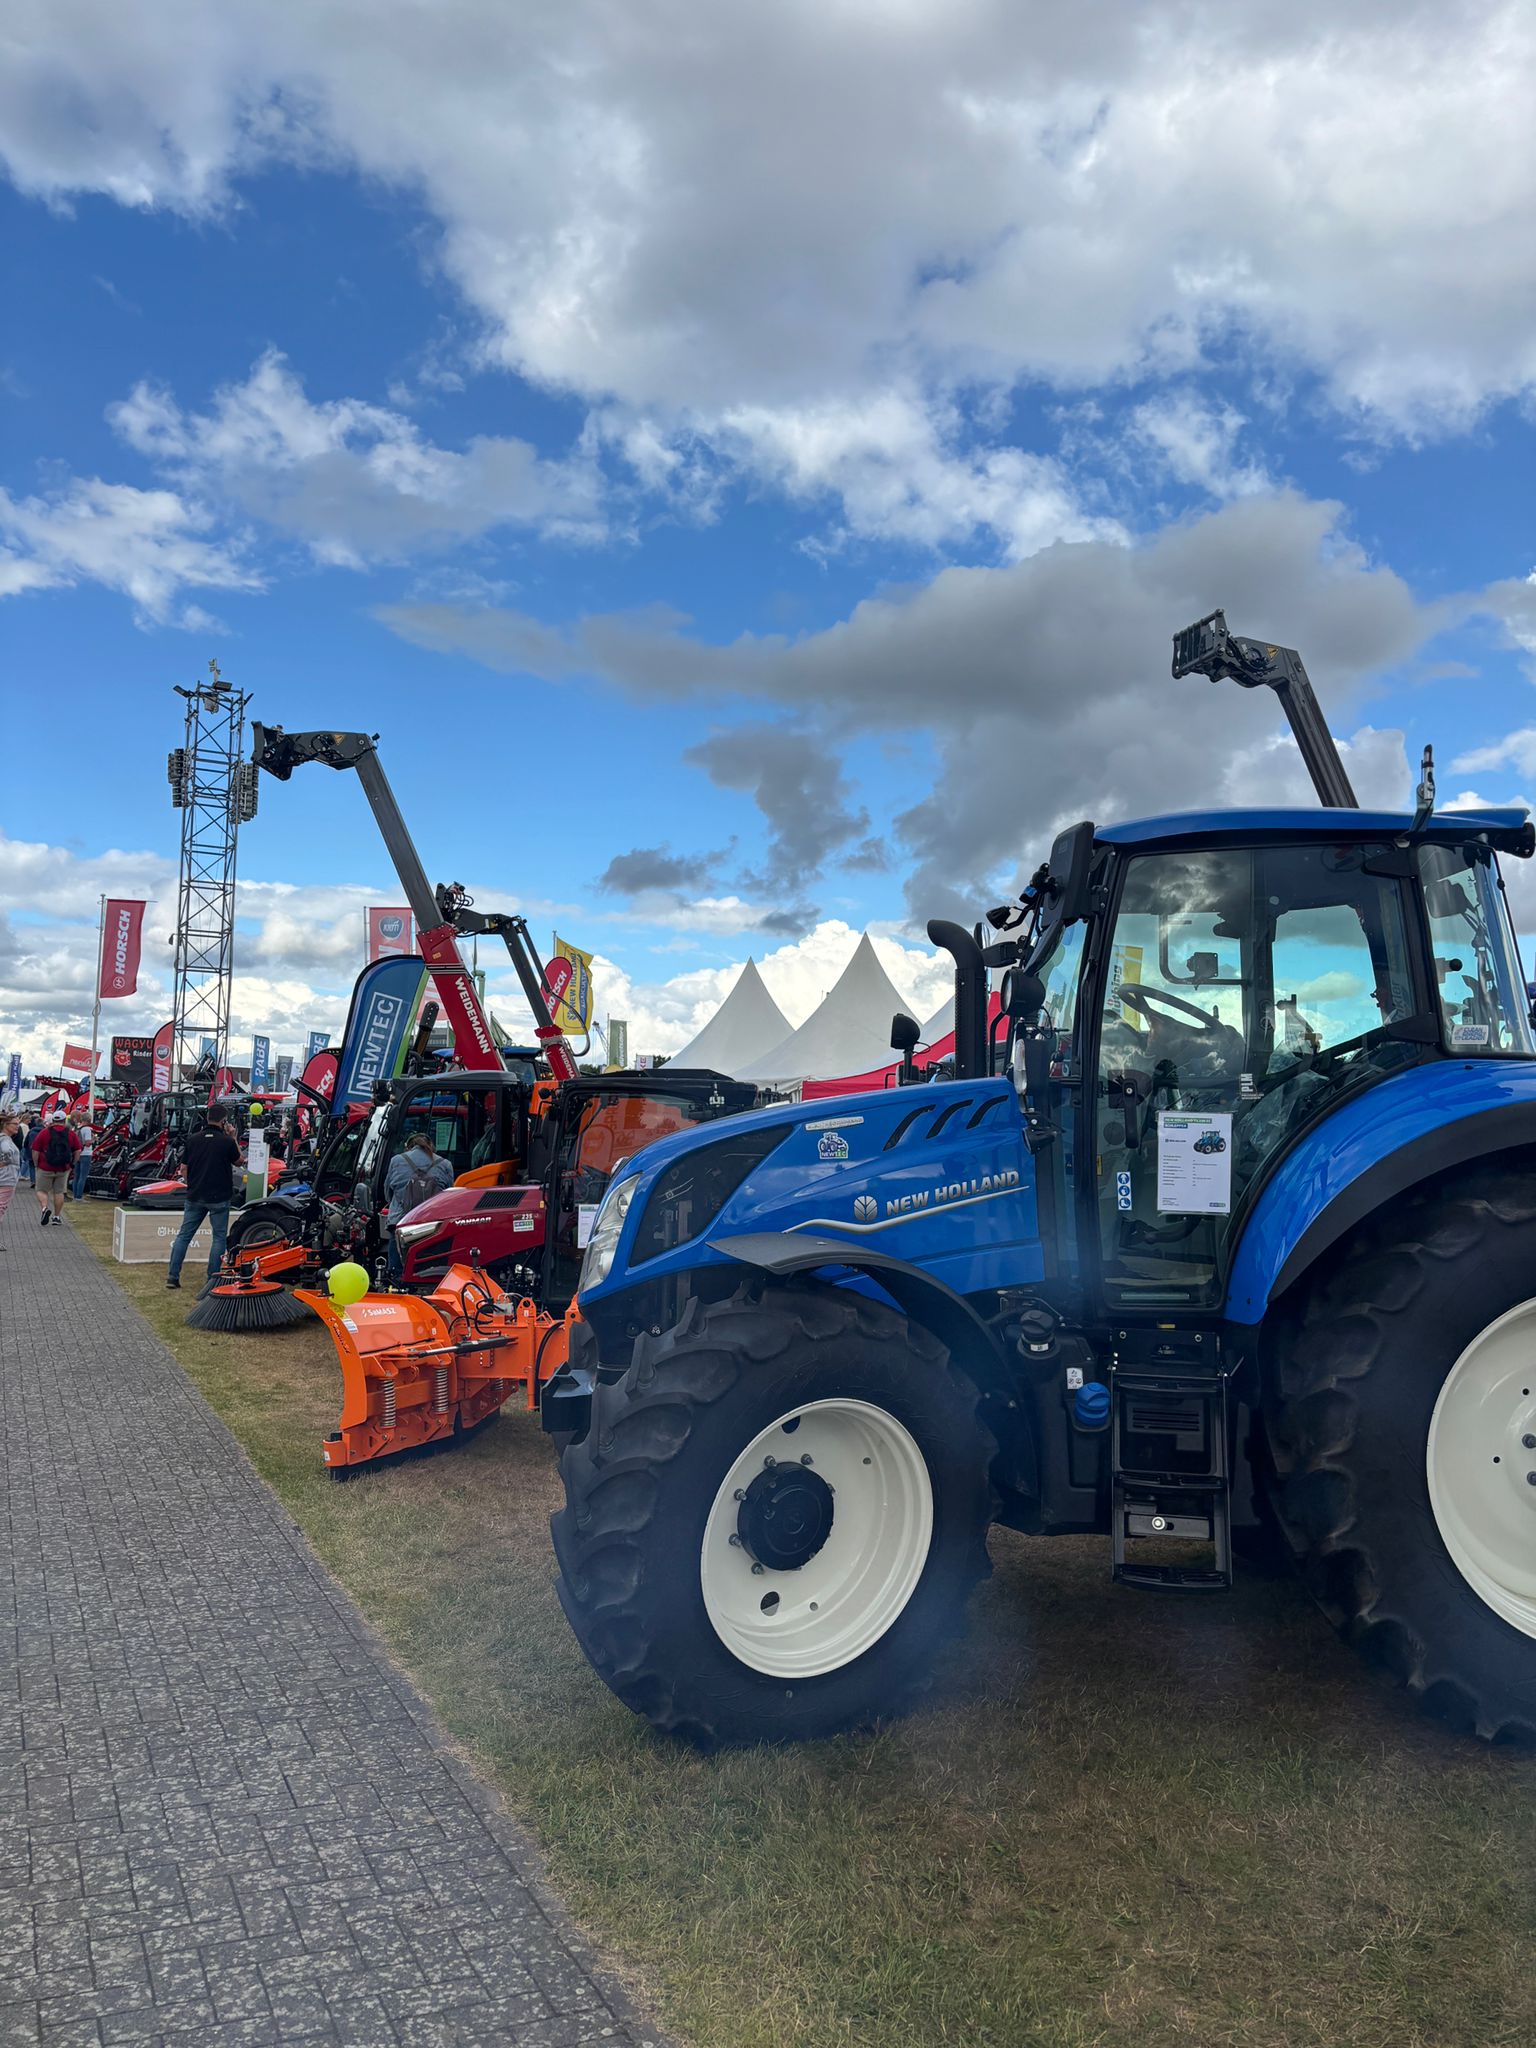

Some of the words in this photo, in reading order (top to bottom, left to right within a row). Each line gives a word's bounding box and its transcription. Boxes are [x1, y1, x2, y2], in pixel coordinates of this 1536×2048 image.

[115, 909, 131, 975] HORSCH
[569, 989, 577, 1007] NEW
[454, 976, 491, 1055] WEIDEMANN
[114, 1039, 153, 1049] WAGYU
[254, 1040, 266, 1077] RABE
[356, 999, 394, 1092] NEWTEC
[558, 1046, 575, 1080] WEIDEMA
[1240, 1073, 1254, 1092] PLM
[886, 1191, 929, 1216] NEW
[934, 1170, 1019, 1203] HOLLAND
[167, 1227, 212, 1235] Hurna
[454, 1216, 492, 1225] YANMAR
